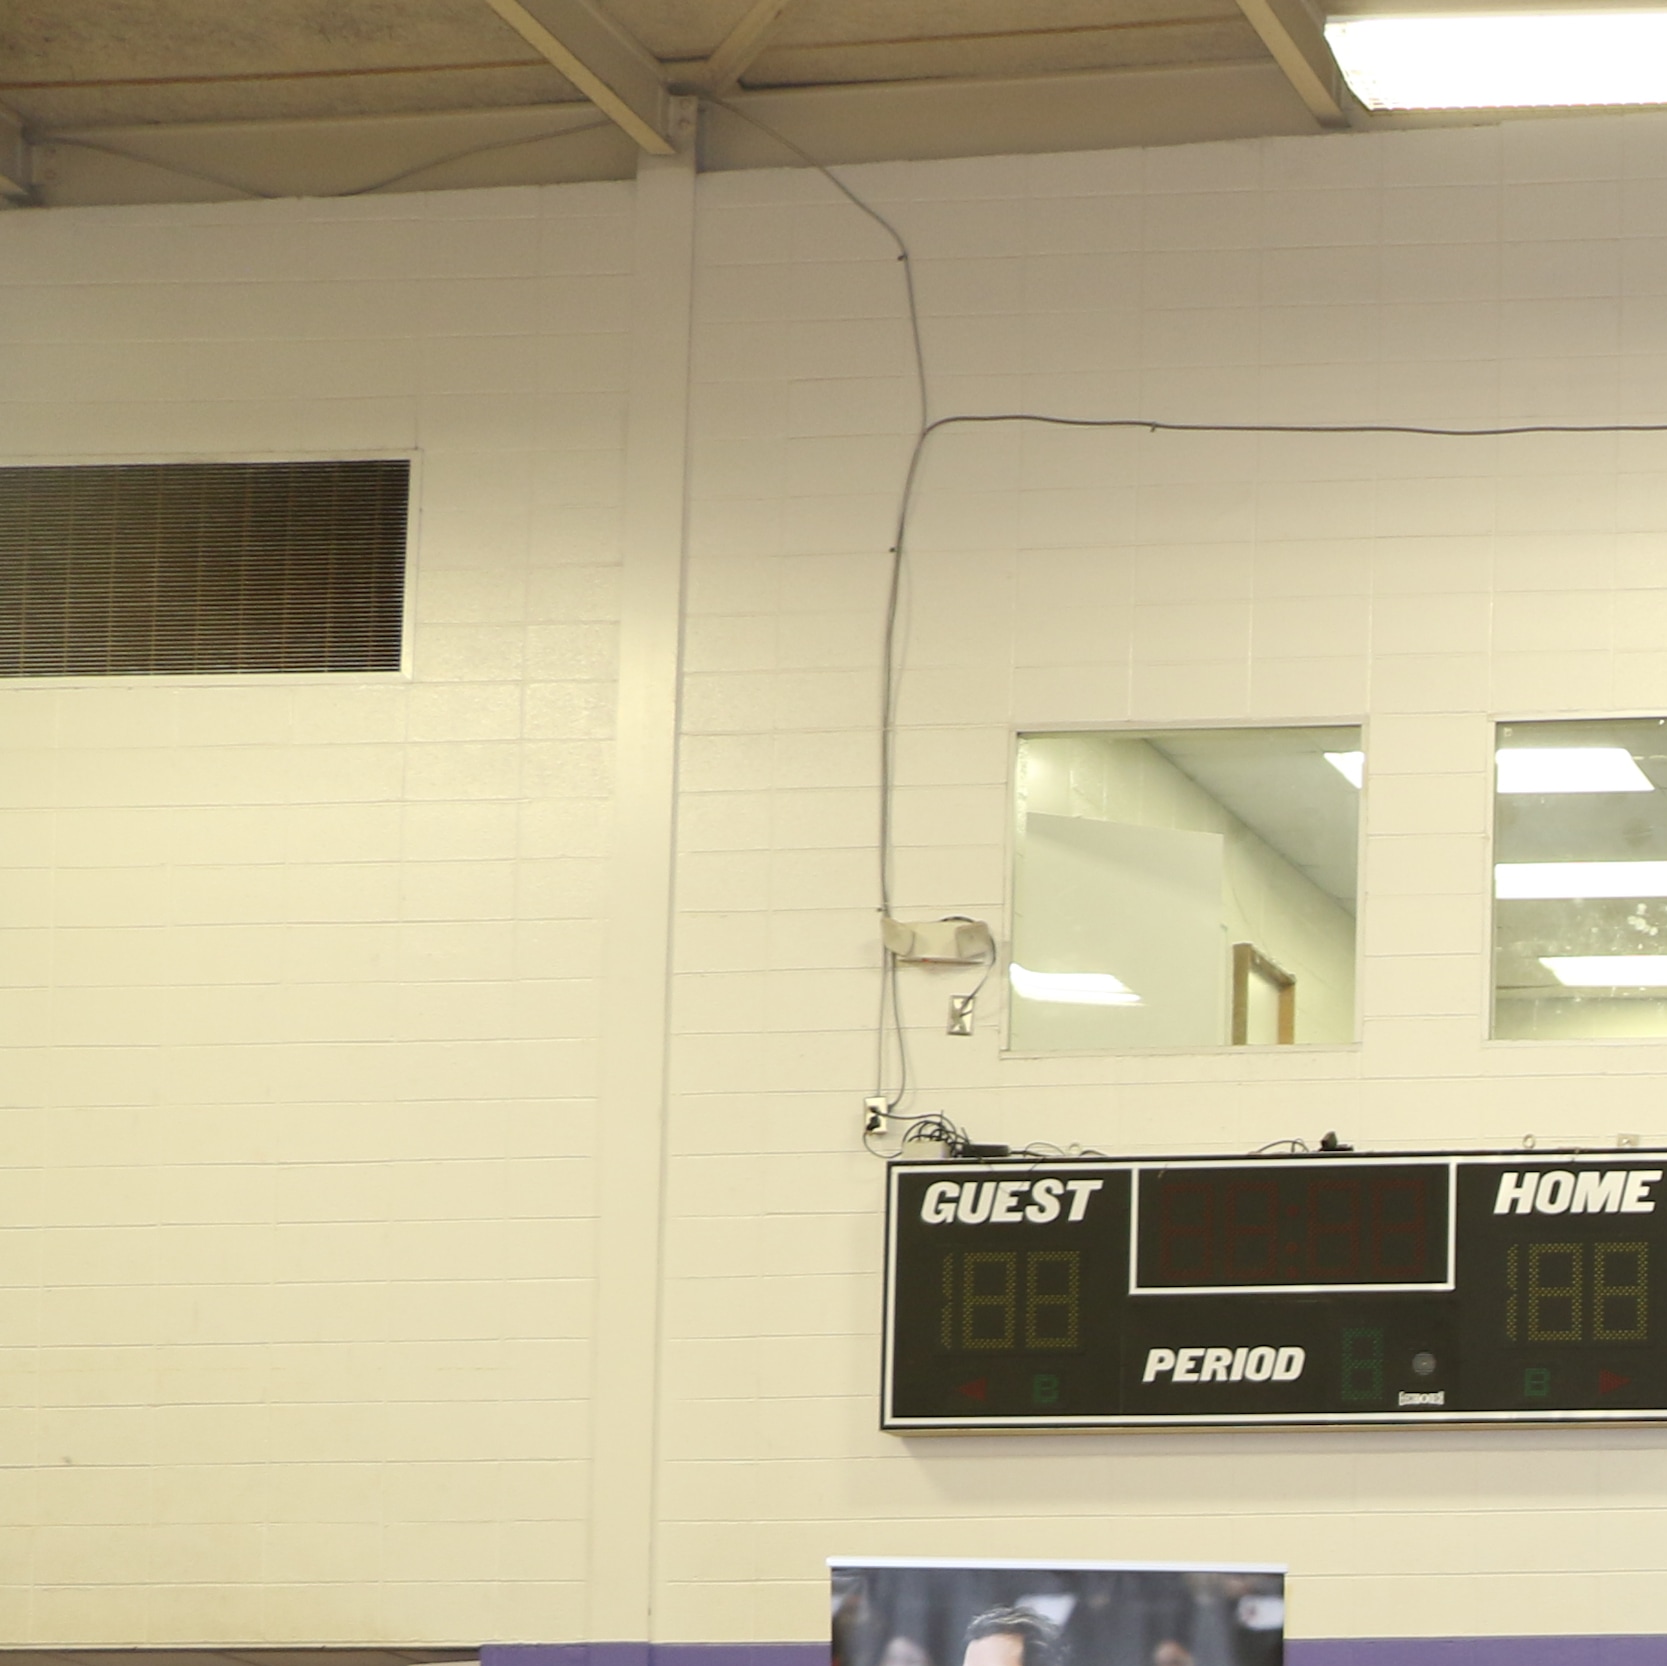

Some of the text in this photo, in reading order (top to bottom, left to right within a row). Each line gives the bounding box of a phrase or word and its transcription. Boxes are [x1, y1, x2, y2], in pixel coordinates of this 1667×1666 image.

[920, 1179, 1102, 1224] GUEST
[1494, 1170, 1663, 1214] HOME
[1142, 1346, 1306, 1383] PERIOD
